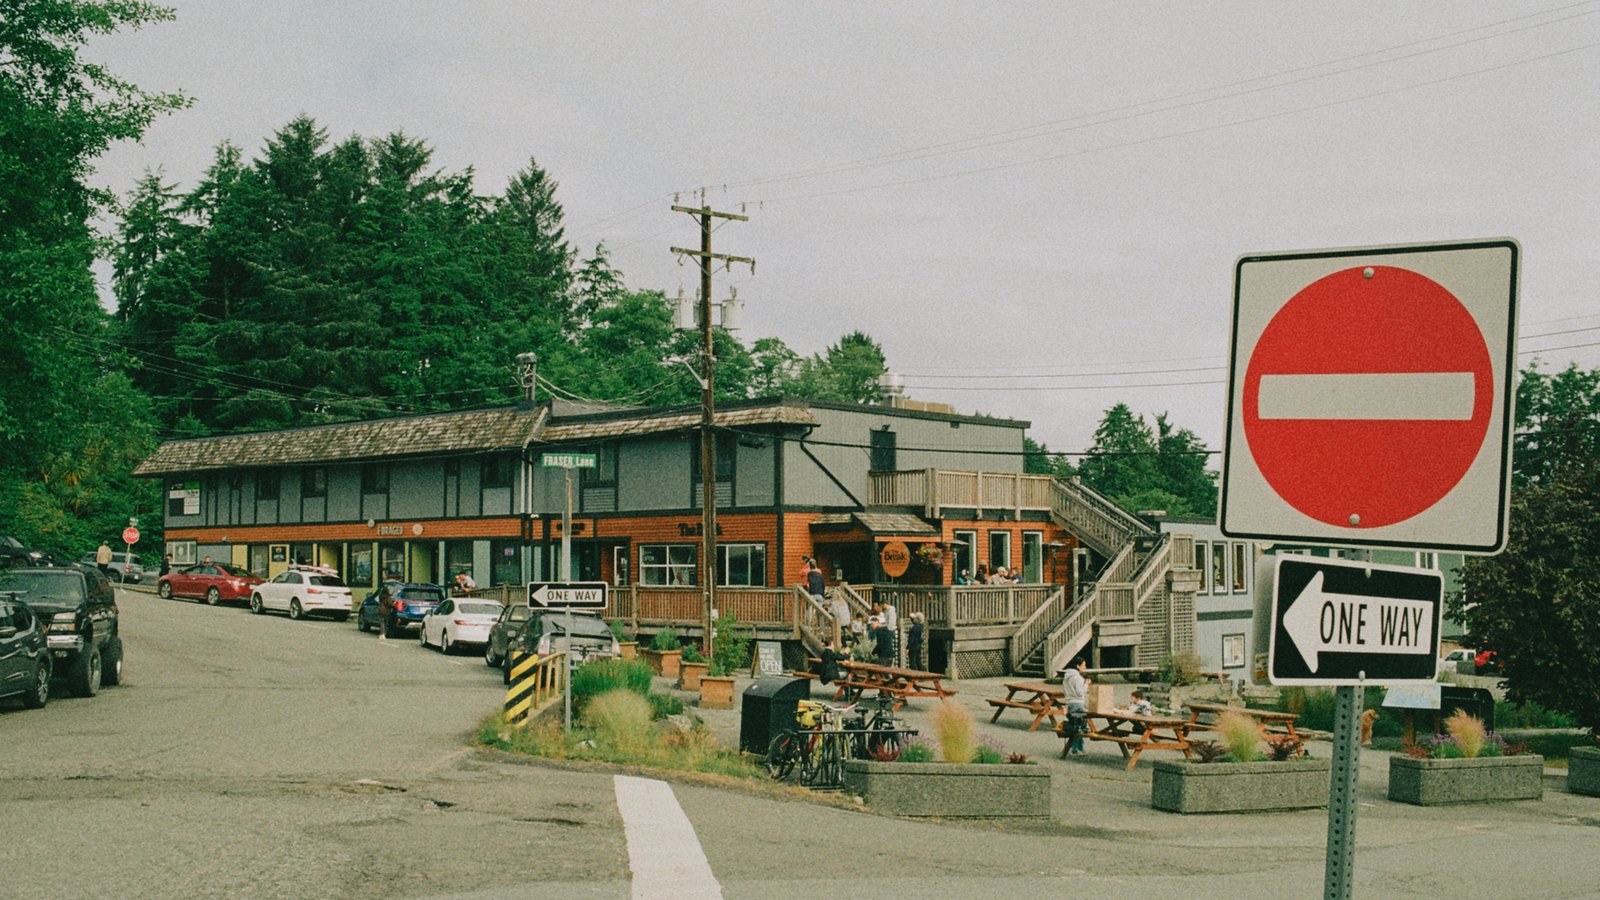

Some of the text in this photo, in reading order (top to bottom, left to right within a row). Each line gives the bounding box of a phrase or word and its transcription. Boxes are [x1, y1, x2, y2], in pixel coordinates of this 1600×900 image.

[544, 456, 594, 466] FRASER Lane
[124, 531, 139, 539] STOP
[547, 591, 597, 601] ONE WAY
[1320, 600, 1423, 647] ONE WAY
[760, 660, 782, 673] OPEN
